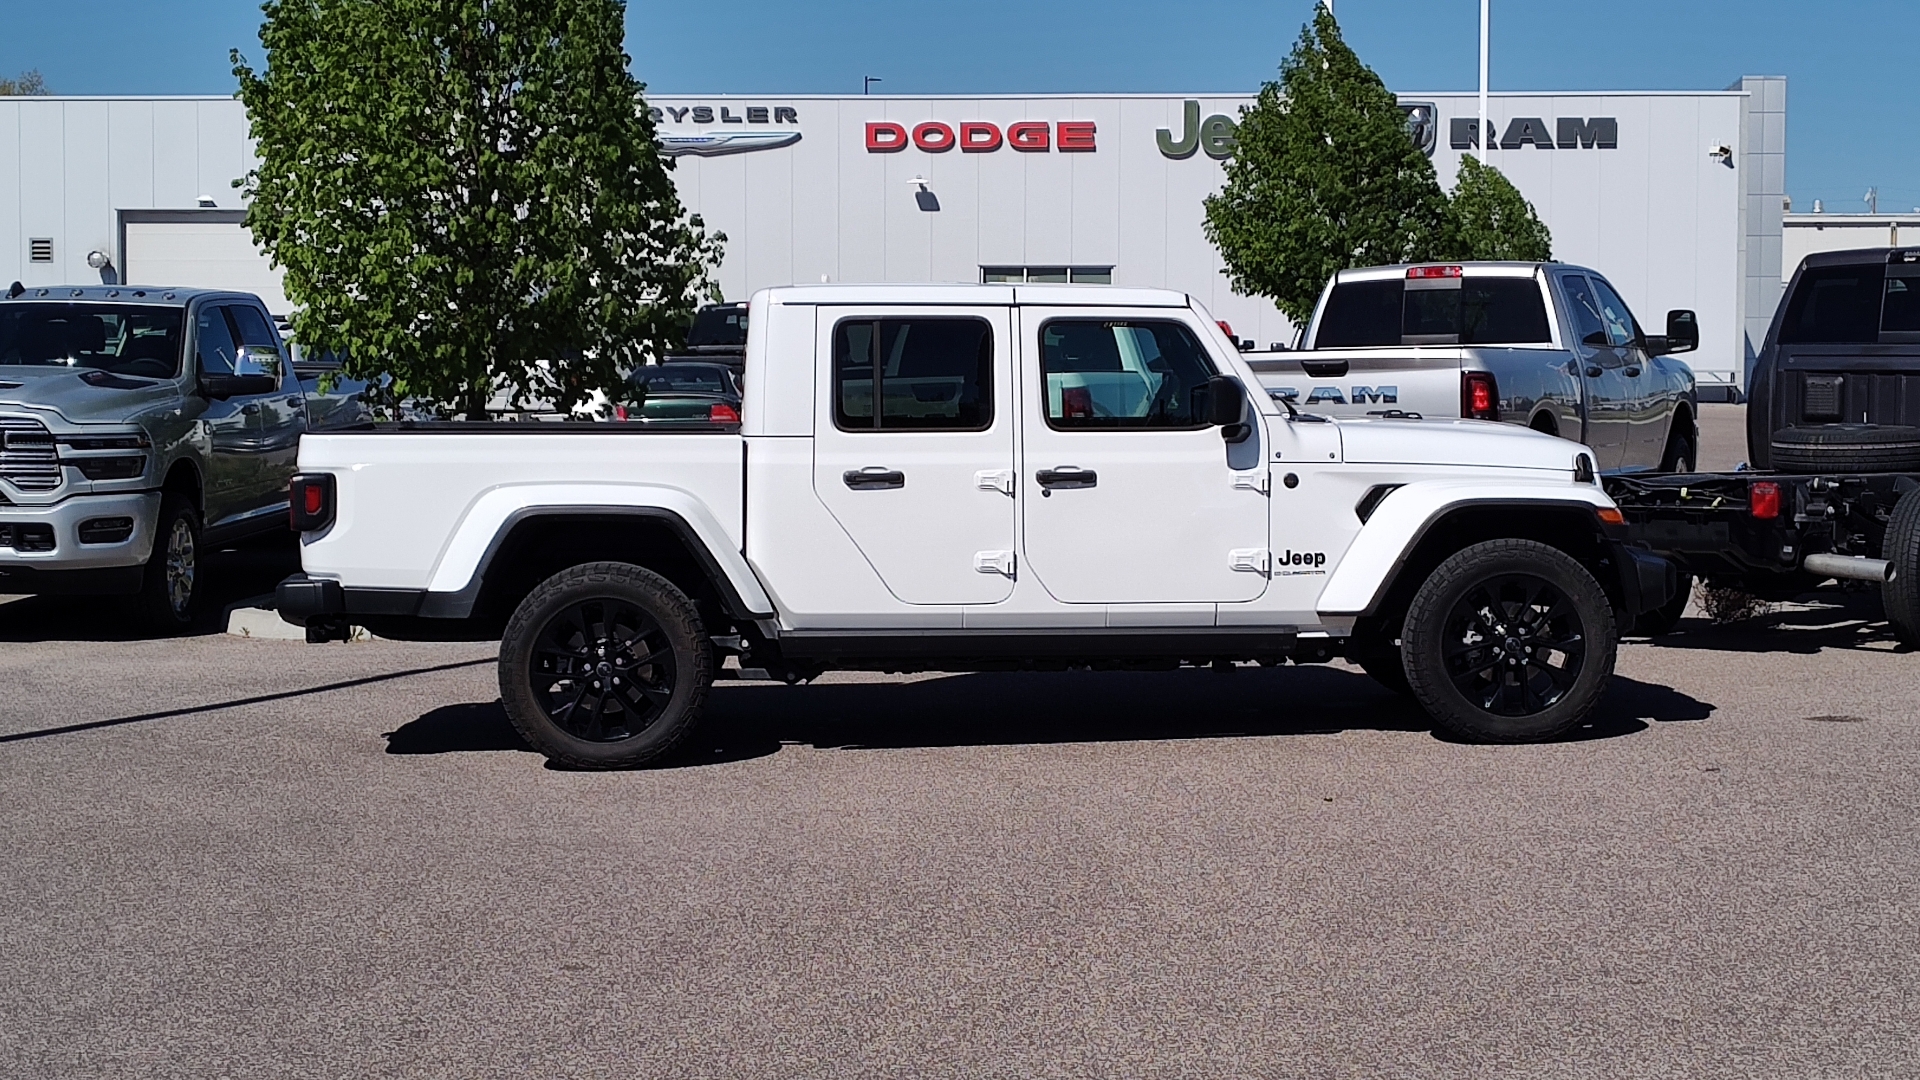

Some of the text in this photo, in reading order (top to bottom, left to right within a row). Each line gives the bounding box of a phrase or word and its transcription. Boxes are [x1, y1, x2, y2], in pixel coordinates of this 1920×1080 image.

[646, 106, 799, 124] RYSLER
[866, 121, 1097, 153] DODGE
[1156, 100, 1240, 160] Je
[1450, 117, 1617, 150] RAM
[1264, 386, 1398, 405] RAM
[1278, 550, 1326, 568] Jeep
